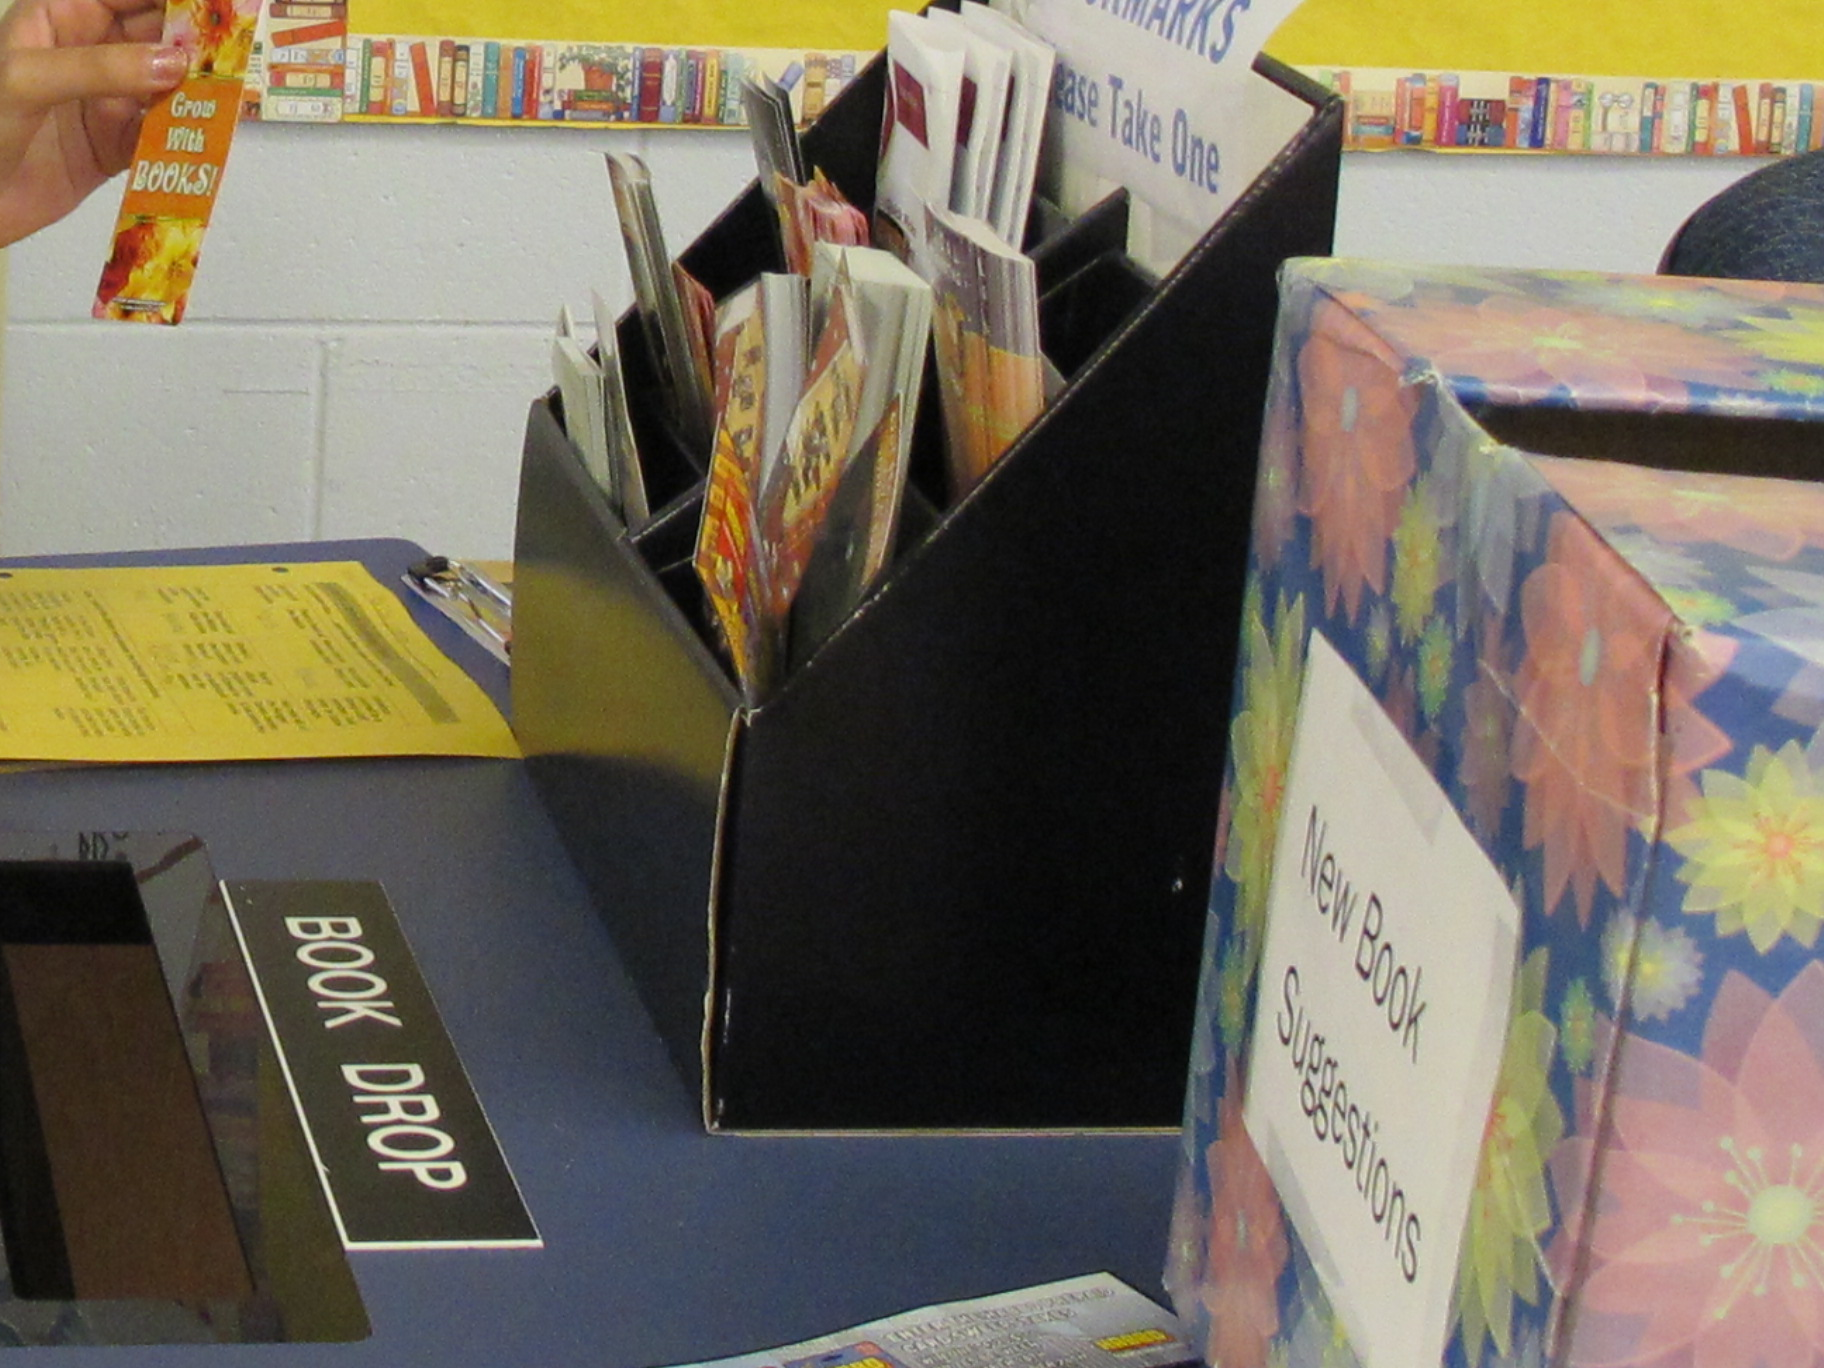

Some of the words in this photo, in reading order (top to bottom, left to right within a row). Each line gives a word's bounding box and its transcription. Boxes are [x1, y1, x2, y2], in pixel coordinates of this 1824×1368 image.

[165, 126, 204, 153] With
[171, 91, 217, 119] Grow
[1108, 73, 1161, 163] Take
[1171, 108, 1219, 194] One
[131, 160, 219, 196] BOOKS!
[284, 916, 403, 1028] BOOK
[1302, 804, 1358, 943] New
[1355, 893, 1427, 1064] Book
[340, 1064, 468, 1190] DROP
[1276, 965, 1421, 1284] Suggestions
